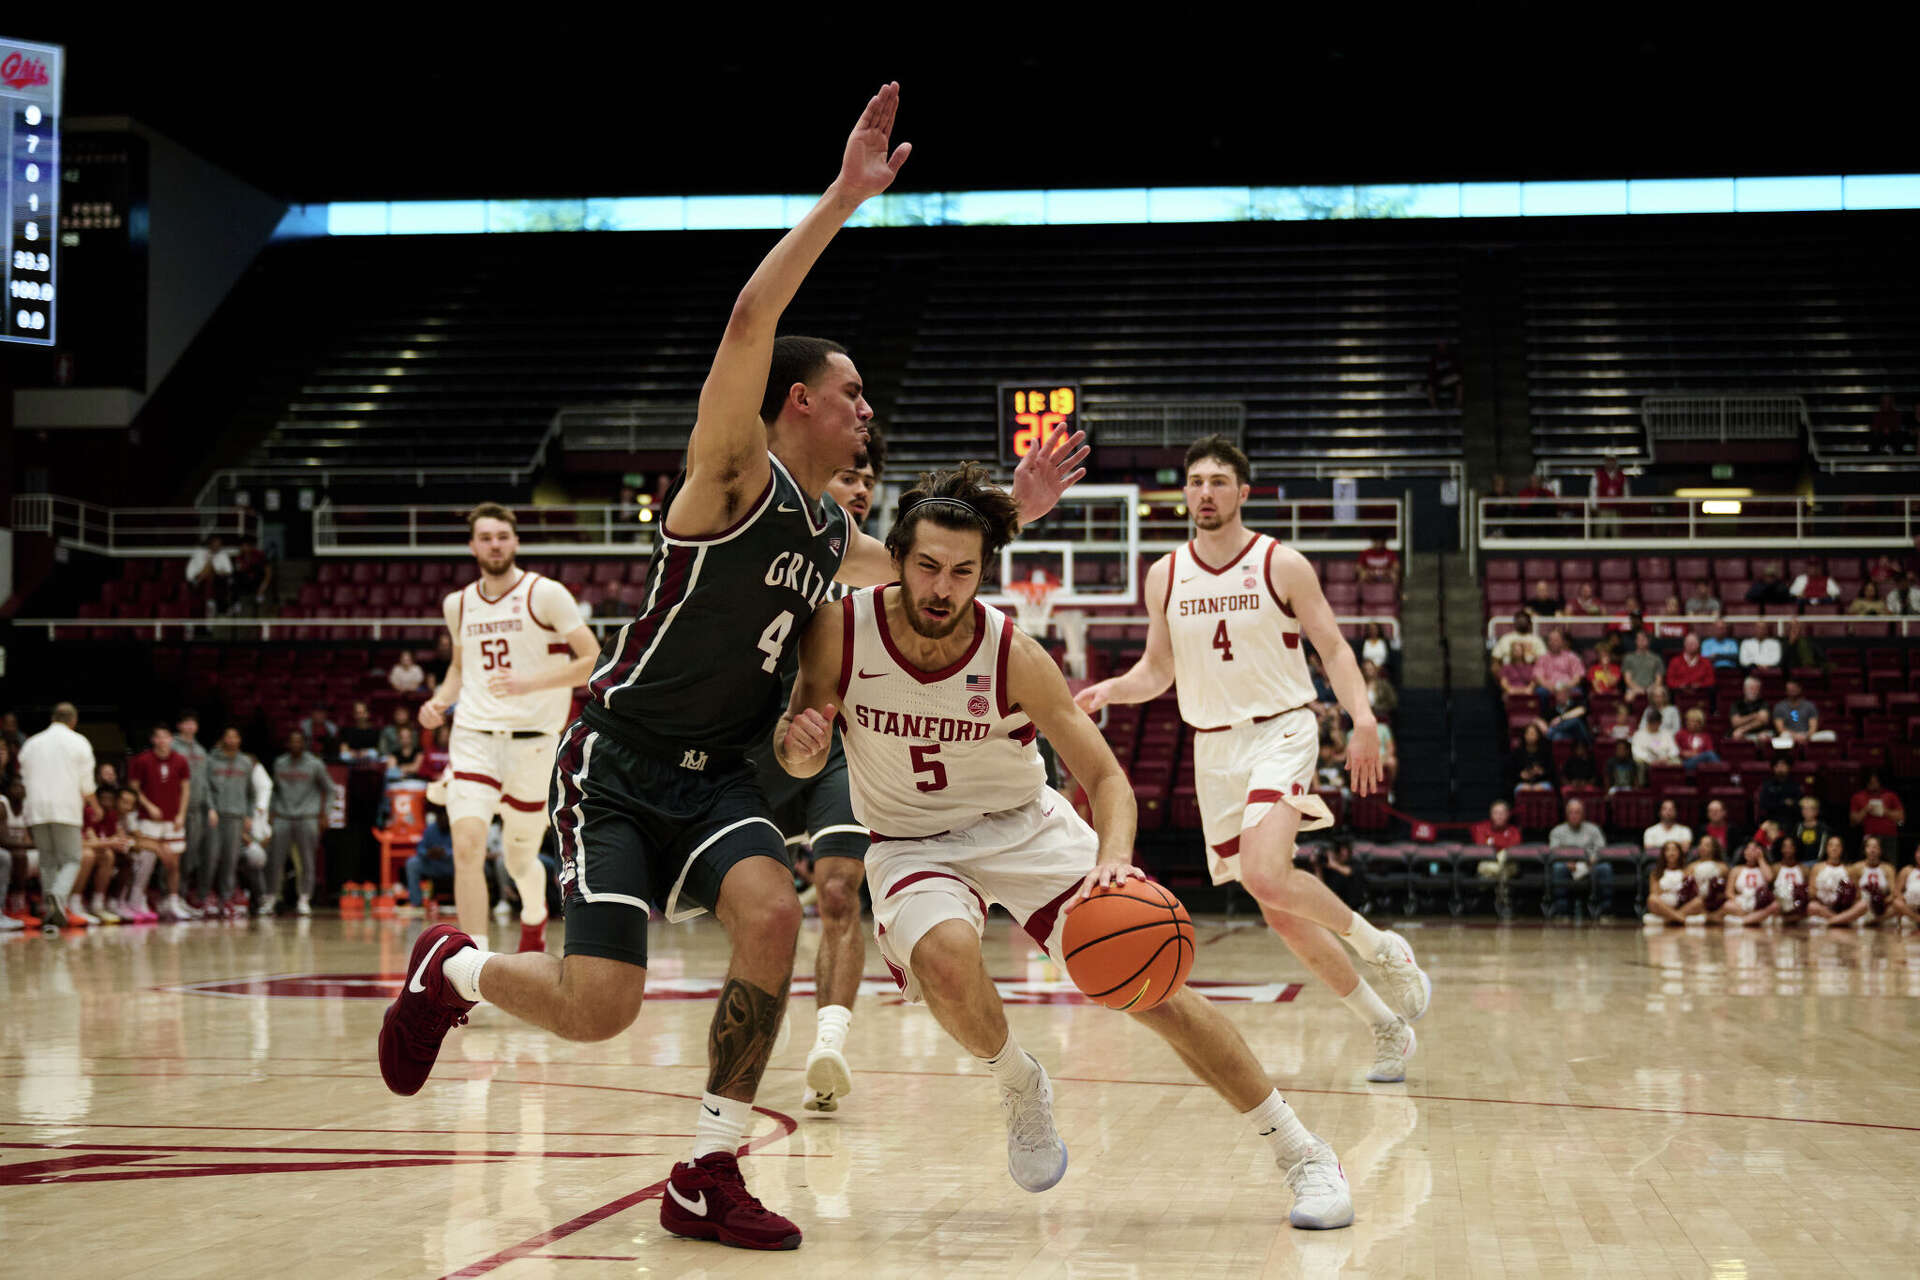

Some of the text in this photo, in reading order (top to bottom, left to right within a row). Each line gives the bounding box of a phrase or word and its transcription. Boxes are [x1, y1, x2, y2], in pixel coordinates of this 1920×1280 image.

[27, 134, 39, 153] 7
[28, 193, 39, 211] 1
[1180, 594, 1259, 616] STANFORD
[481, 638, 511, 670] 52
[757, 609, 795, 674] 4
[1212, 619, 1233, 661] 4
[855, 704, 991, 742] STANFORD
[909, 743, 948, 793] 5
